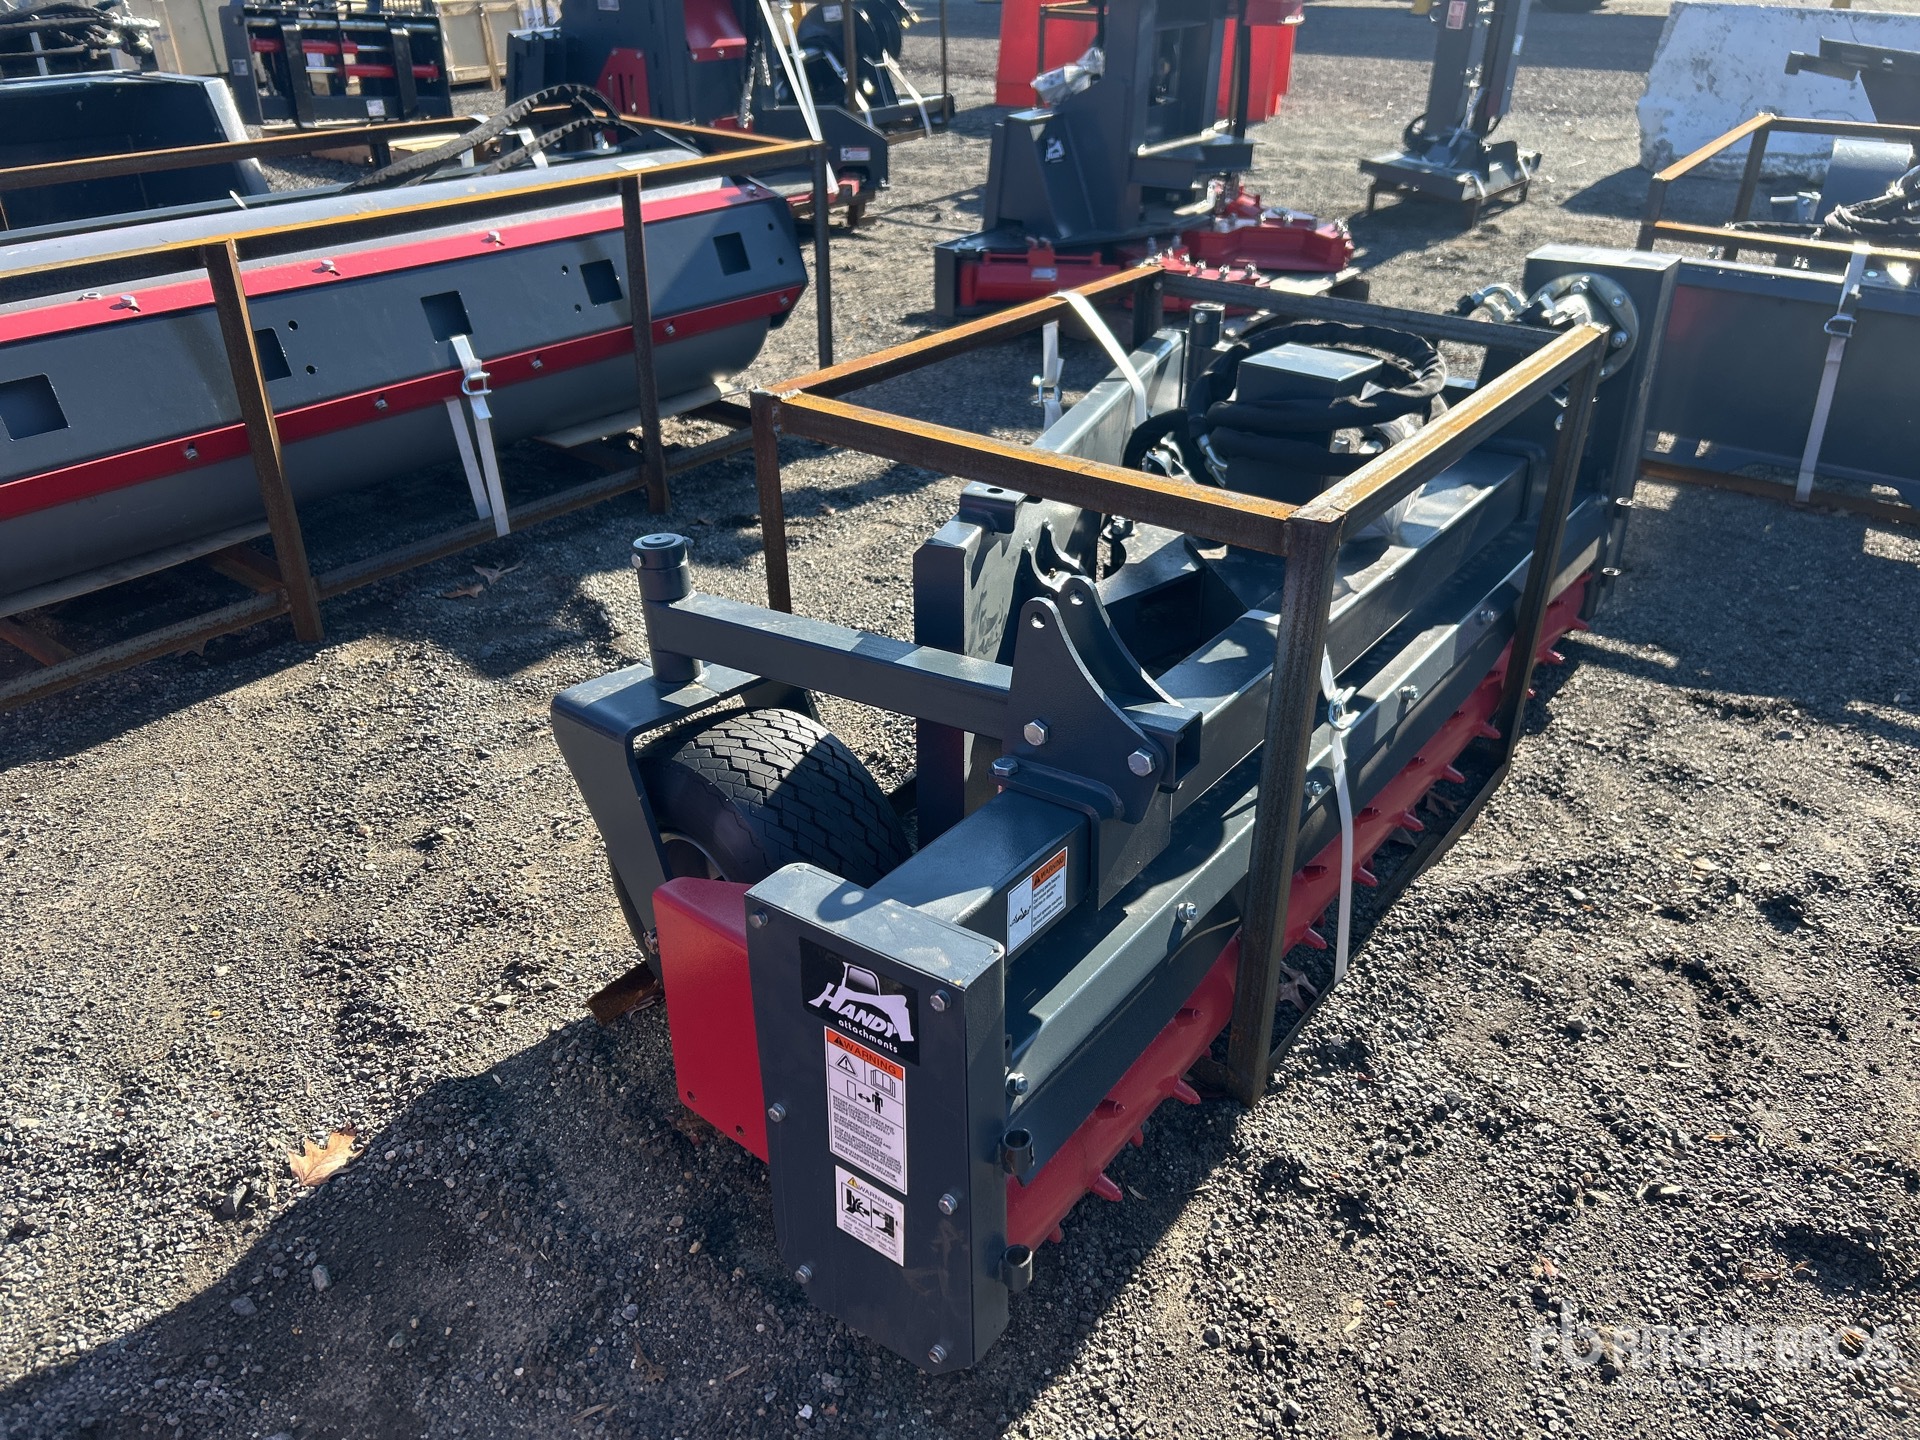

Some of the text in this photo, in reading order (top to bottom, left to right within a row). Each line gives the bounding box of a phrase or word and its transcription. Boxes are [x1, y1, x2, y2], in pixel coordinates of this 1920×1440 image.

[808, 982, 900, 1039] HANDY
[838, 1019, 898, 1053] attachments
[844, 1041, 897, 1075] WARNING
[857, 1184, 894, 1209] WARNING
